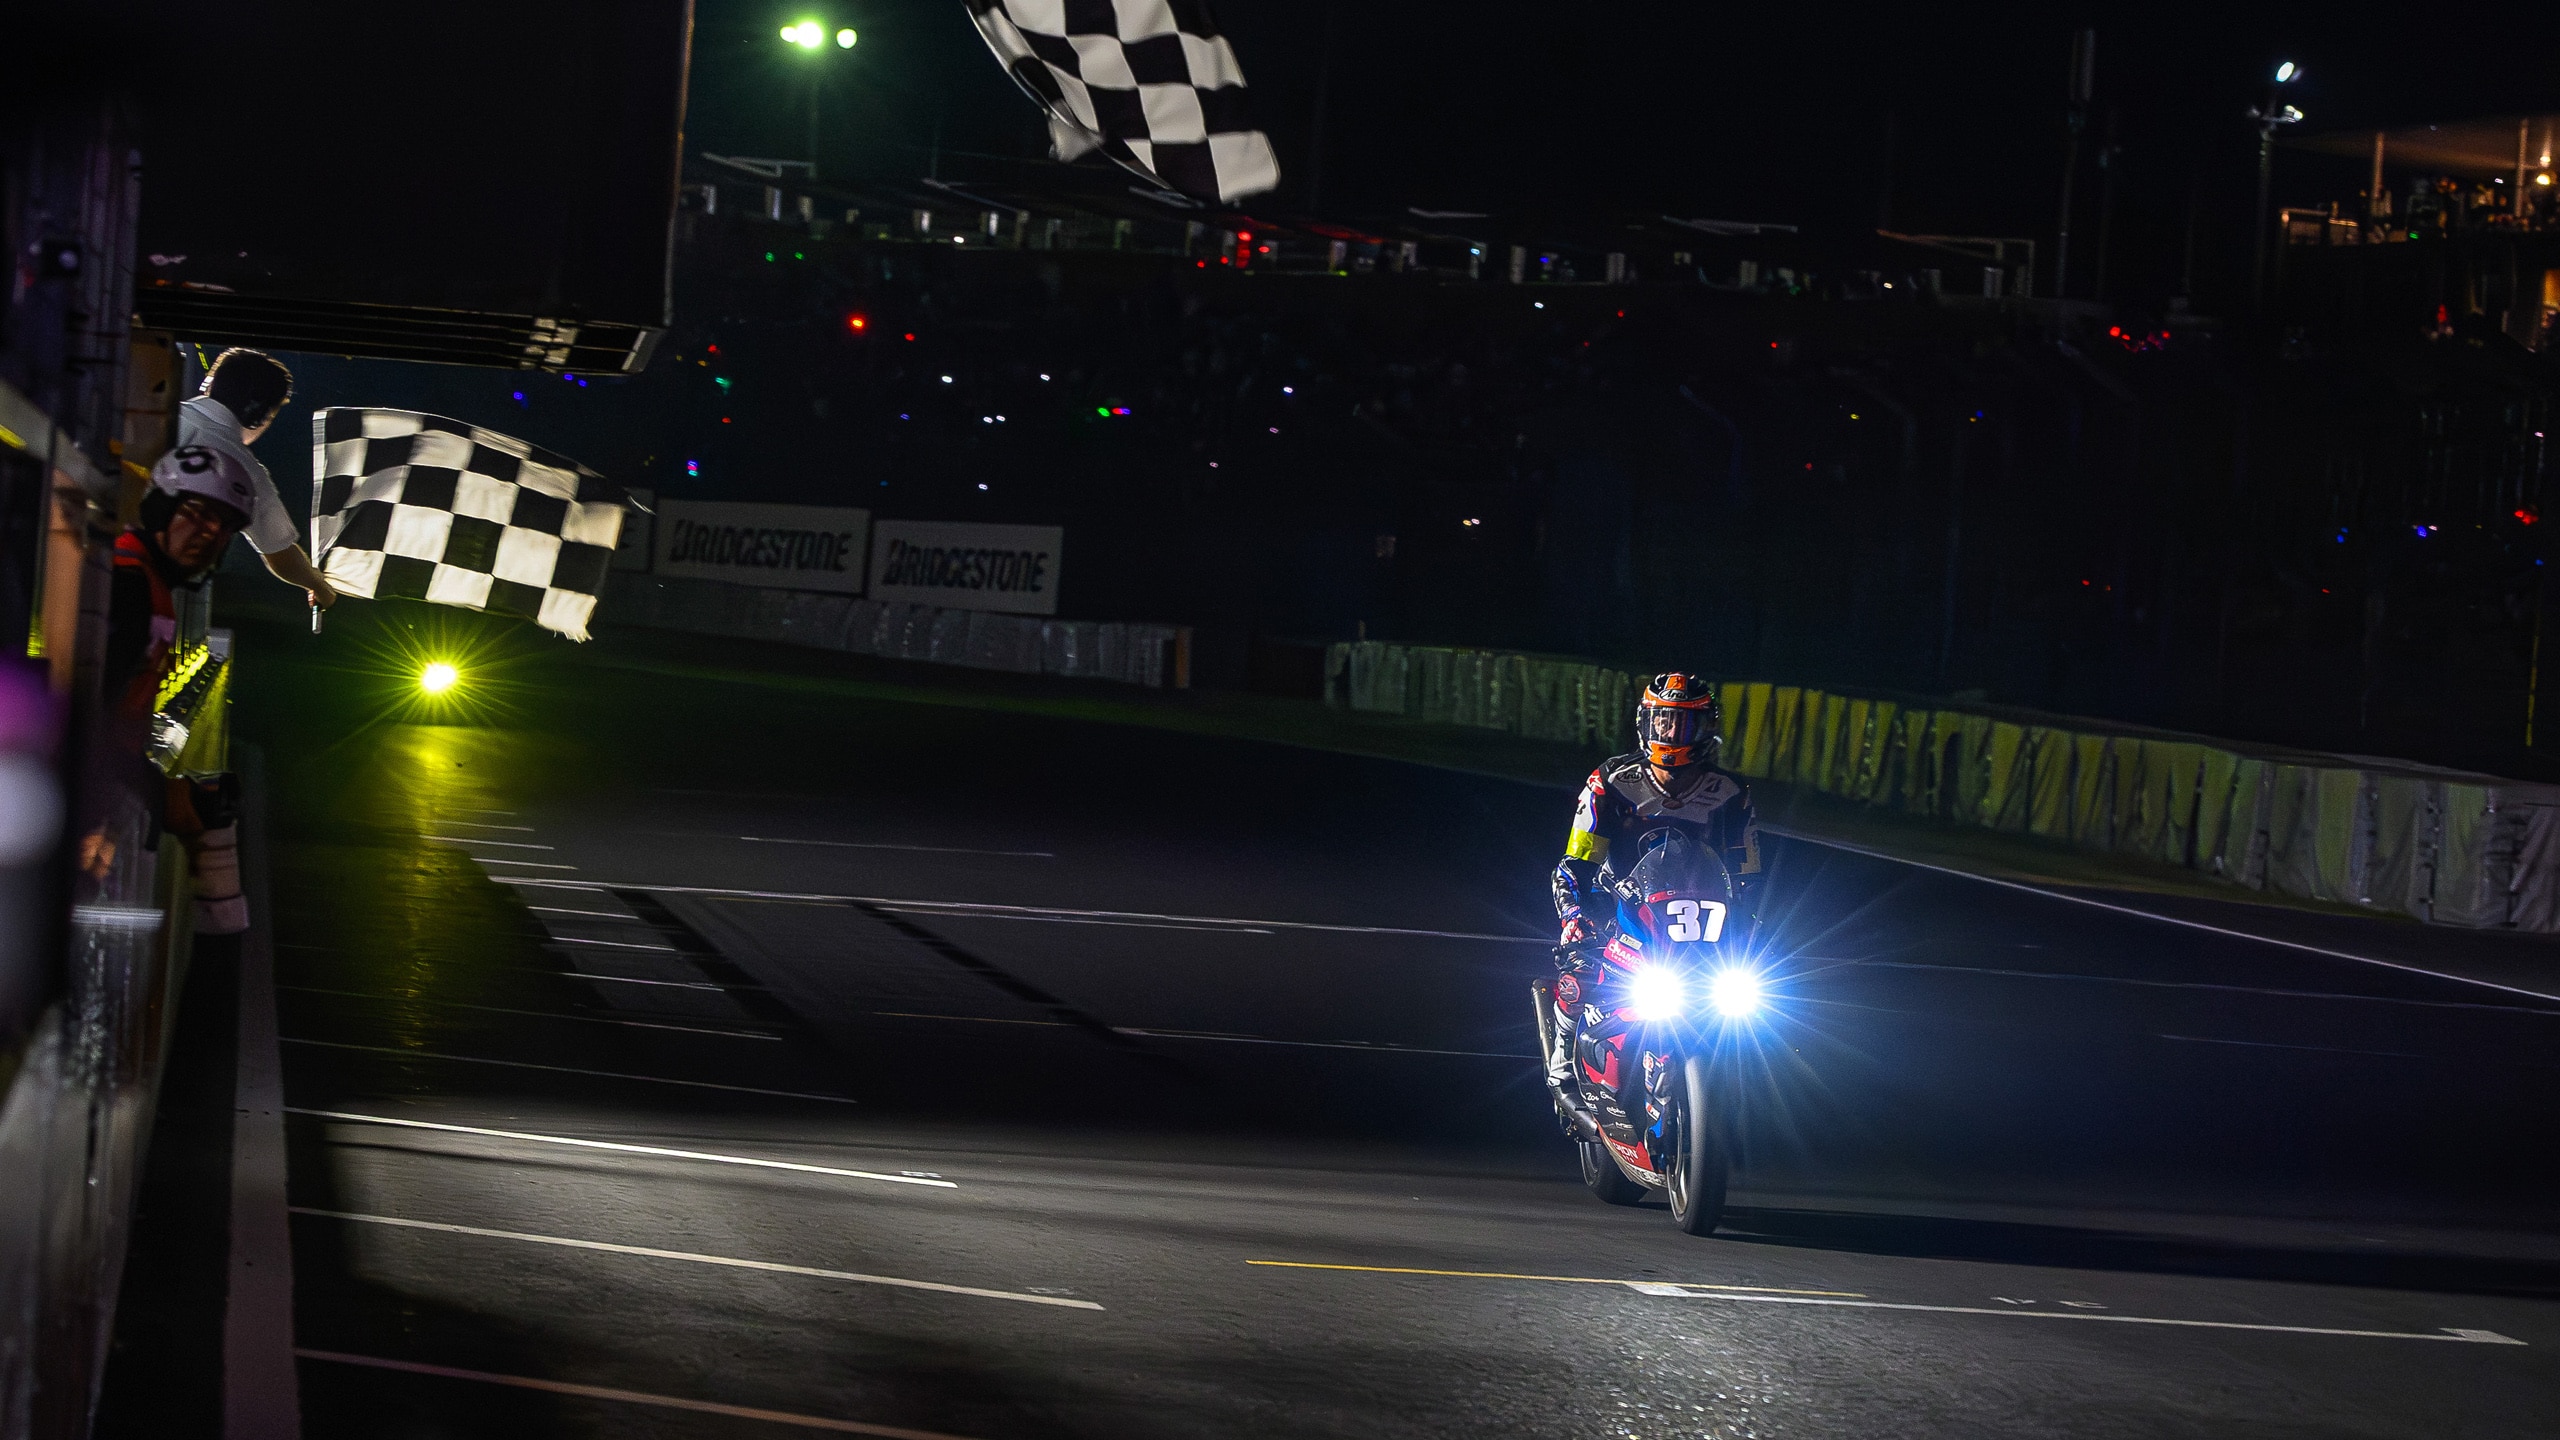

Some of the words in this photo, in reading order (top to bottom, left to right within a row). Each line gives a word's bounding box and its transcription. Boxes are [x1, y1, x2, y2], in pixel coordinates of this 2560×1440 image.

[670, 518, 852, 572] BRIDGESTONE
[882, 538, 1047, 592] BRIDGESTONE
[1666, 899, 1727, 943] 37
